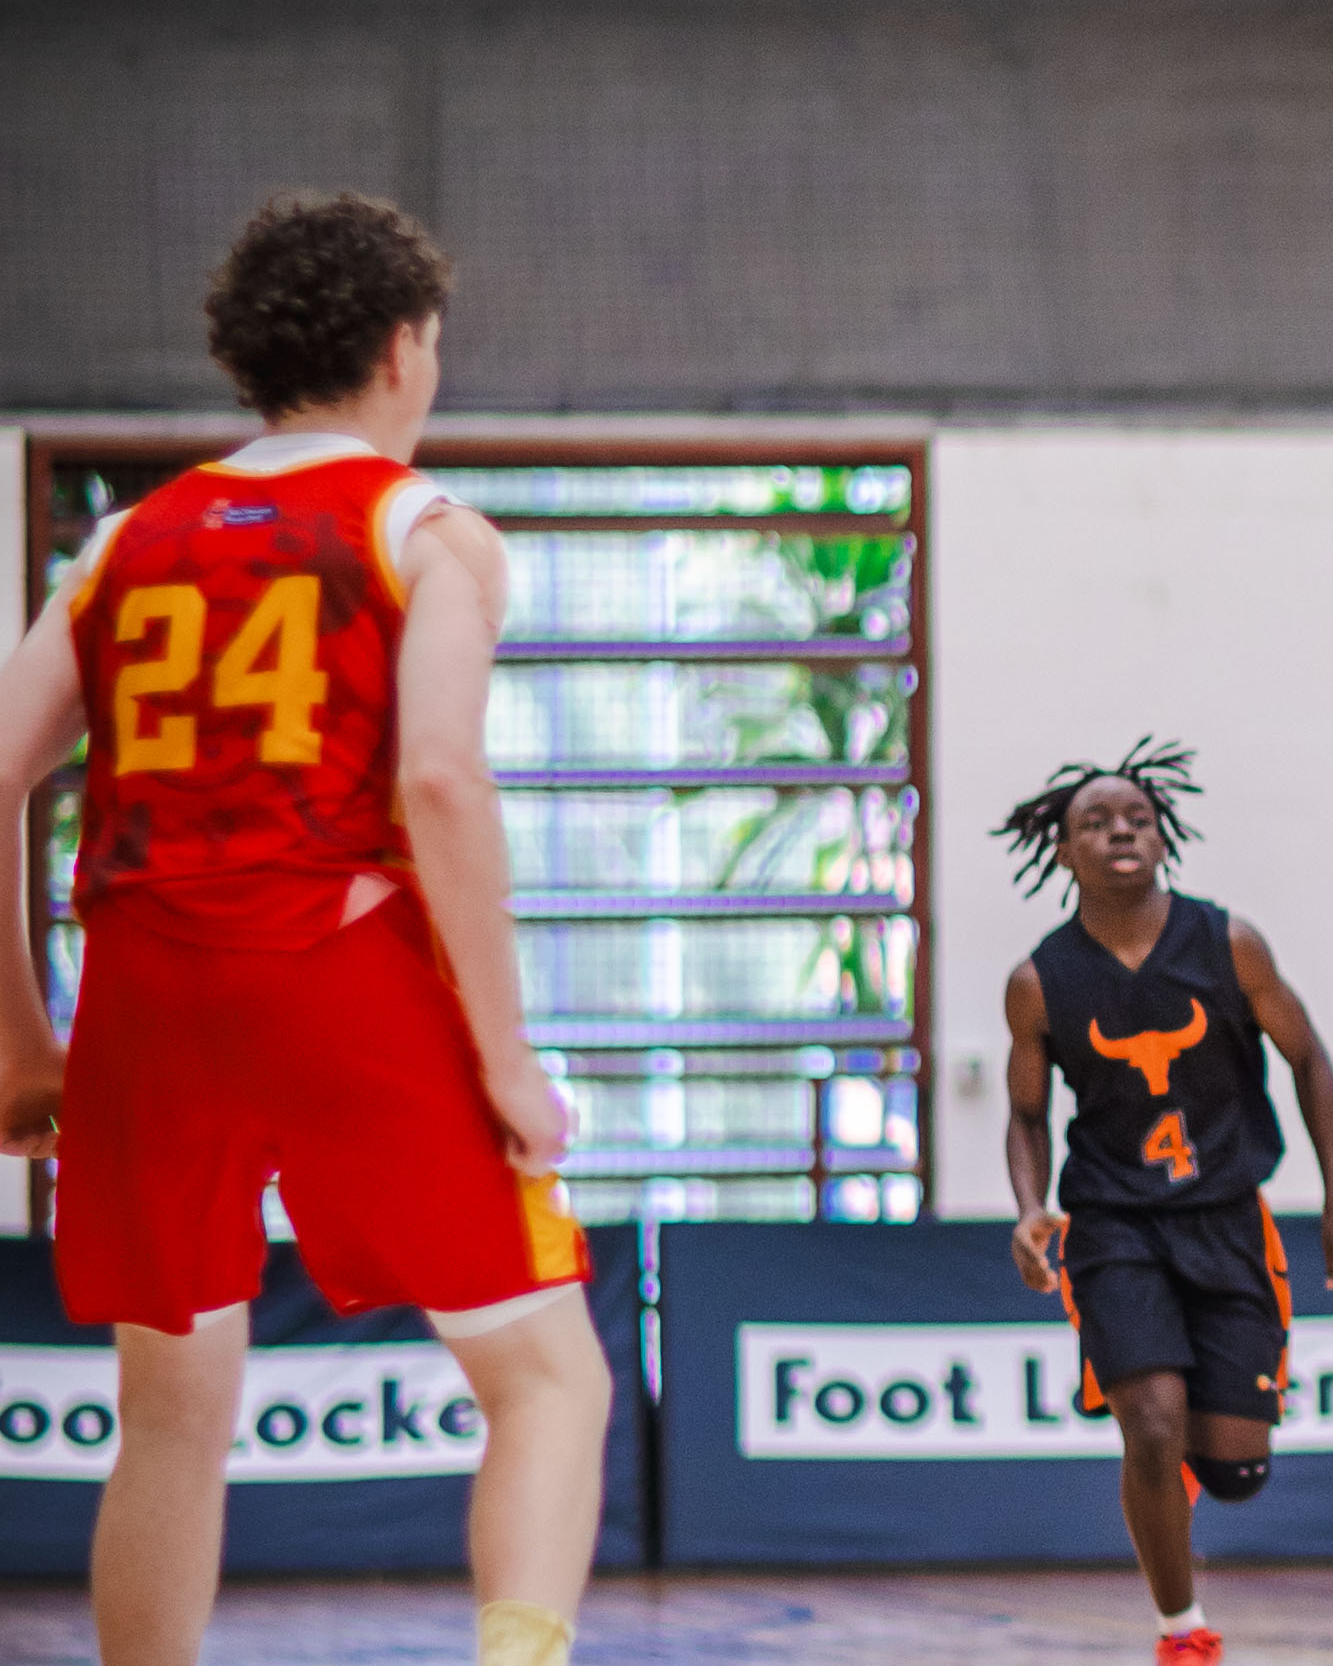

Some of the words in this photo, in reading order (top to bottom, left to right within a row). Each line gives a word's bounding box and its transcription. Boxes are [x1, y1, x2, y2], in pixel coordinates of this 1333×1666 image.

[115, 574, 327, 778] 24
[1140, 1110, 1199, 1184] 4
[775, 1358, 977, 1424] Foot
